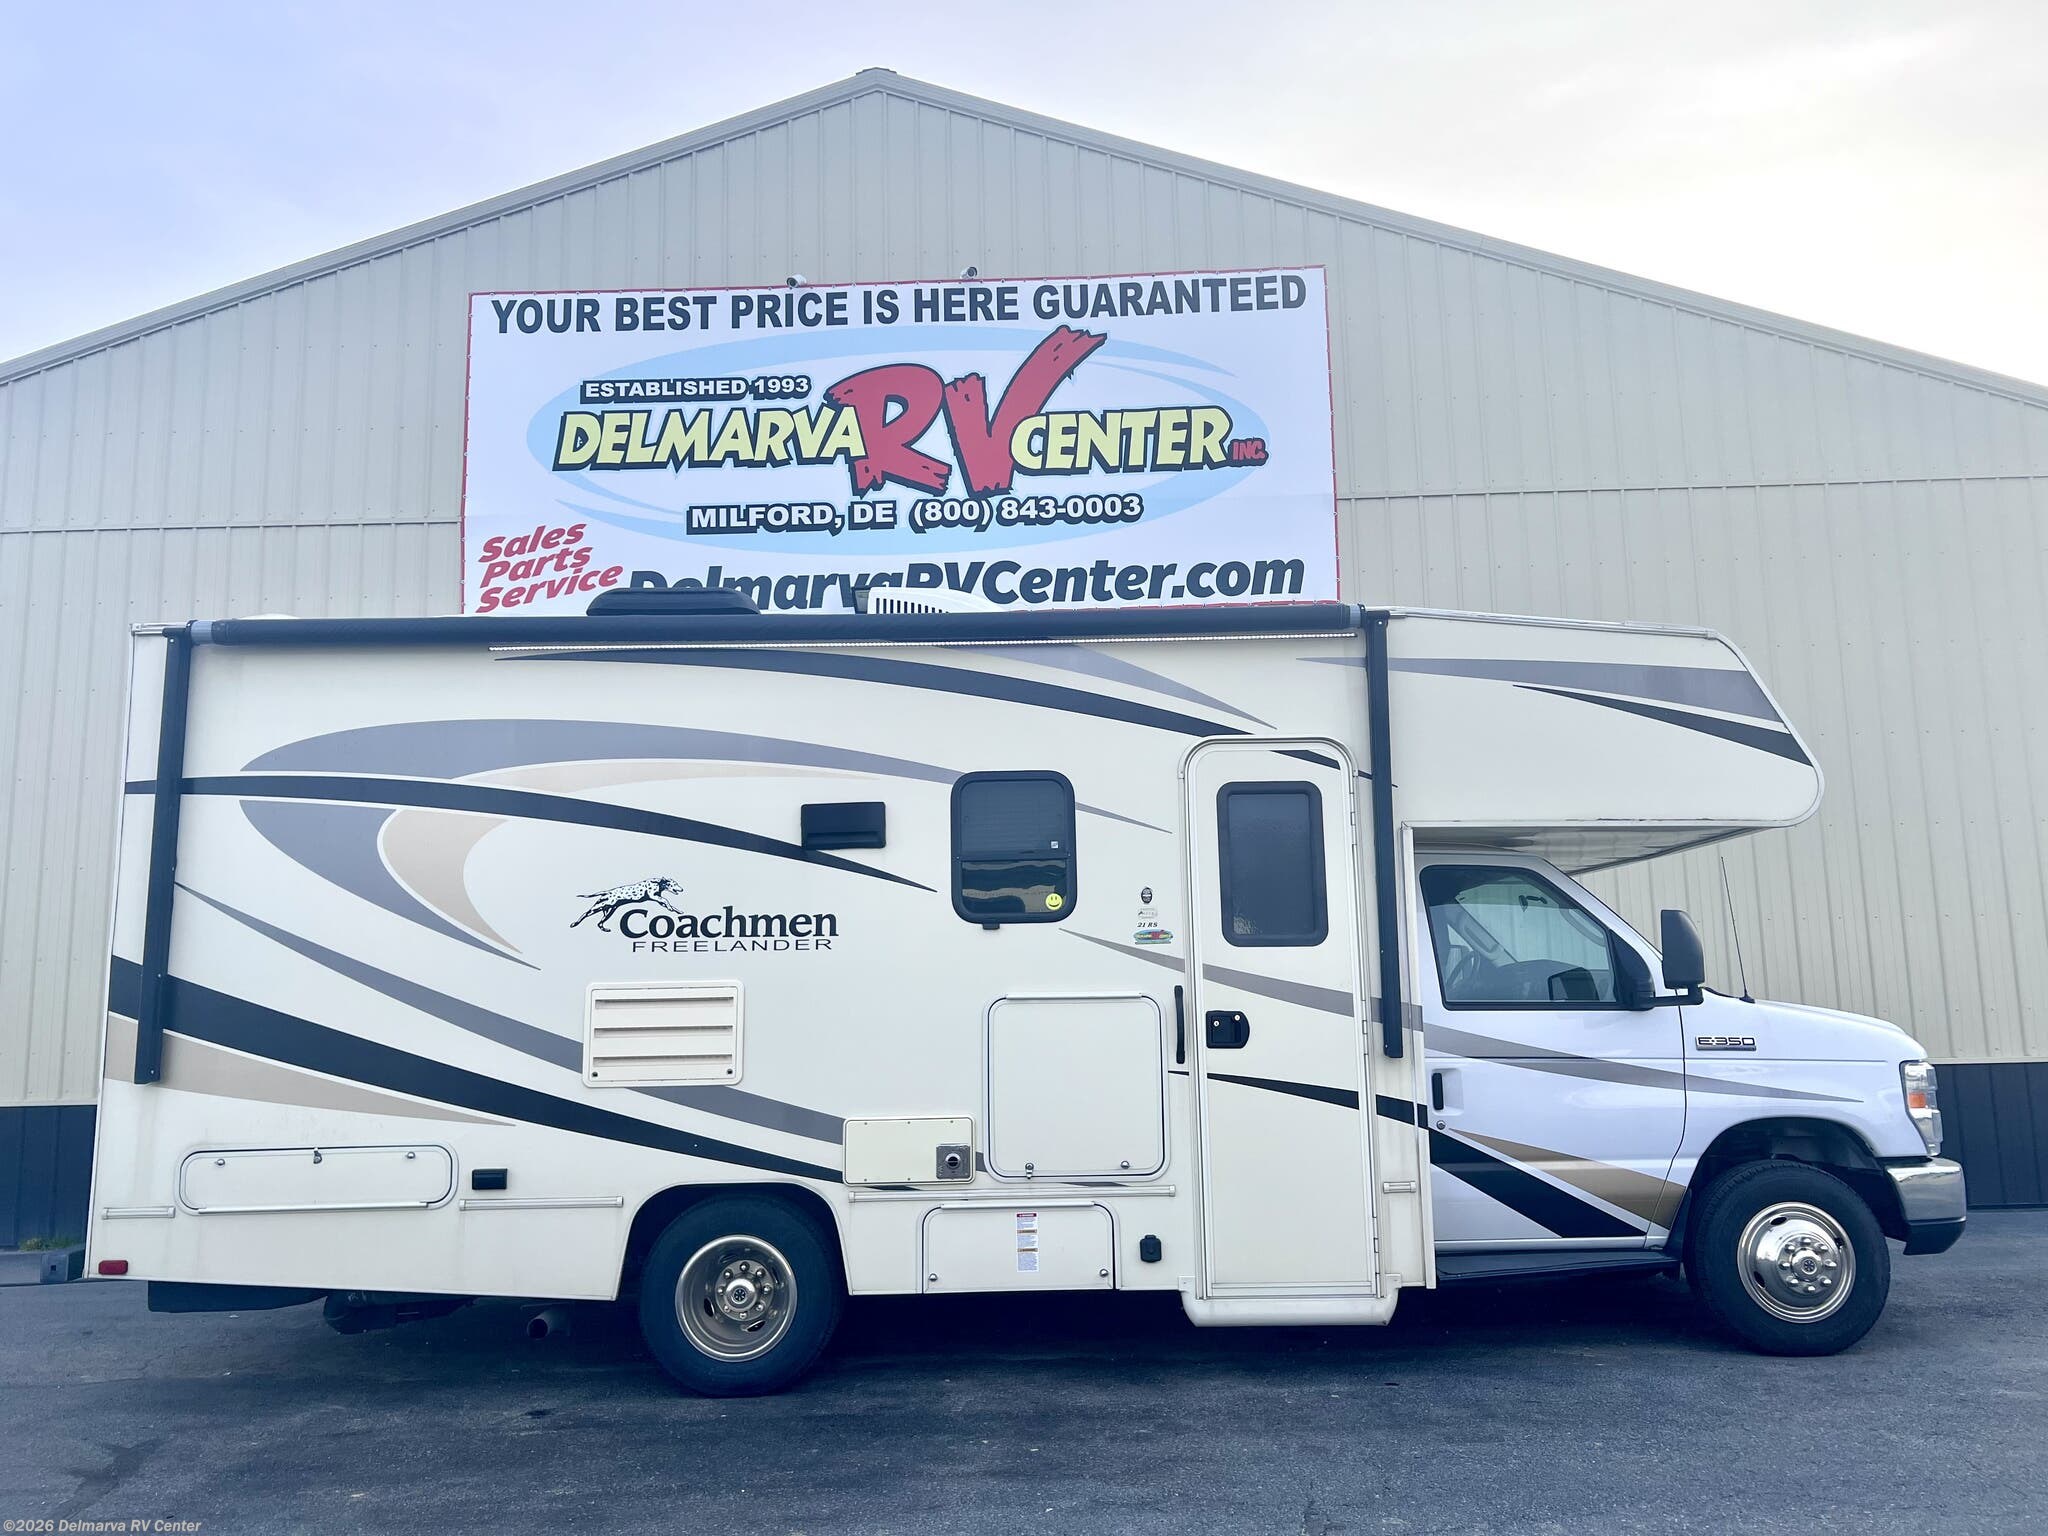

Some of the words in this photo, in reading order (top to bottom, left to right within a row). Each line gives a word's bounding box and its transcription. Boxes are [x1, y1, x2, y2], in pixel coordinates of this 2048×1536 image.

[491, 298, 601, 334] YOUR
[615, 295, 718, 332] BEST
[731, 291, 848, 329] PRICE
[863, 289, 900, 325] IS
[913, 286, 1019, 323] HERE
[1033, 274, 1307, 320] GUARANTEED
[583, 378, 747, 399] ESTABLISHED
[753, 377, 810, 397] 1993
[555, 403, 868, 469] DELMARVA
[823, 325, 1107, 497] RV
[1009, 408, 1231, 472] CENTER
[690, 504, 843, 531] MILFORD,
[851, 502, 895, 526] DE
[912, 500, 992, 529] (800)
[1000, 496, 1142, 522] 843-0003
[478, 523, 587, 562] Sales
[479, 547, 593, 588] Parts
[630, 558, 1306, 610] marvRVCenter.com
[475, 565, 624, 613] Service
[620, 905, 839, 938] Coachmen
[632, 938, 832, 952] FREELANDER
